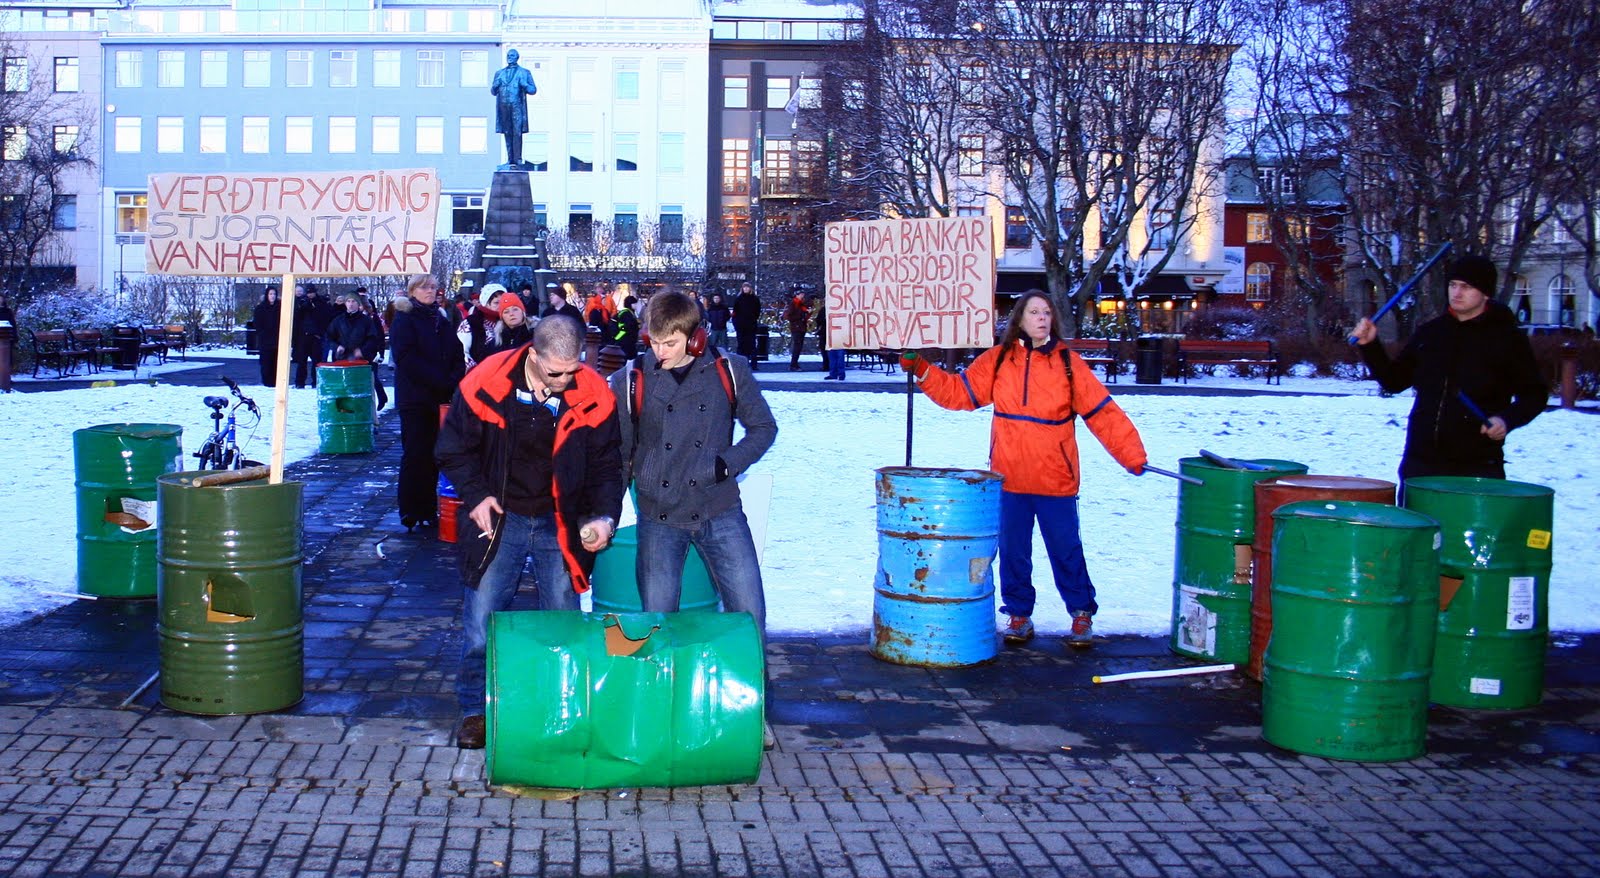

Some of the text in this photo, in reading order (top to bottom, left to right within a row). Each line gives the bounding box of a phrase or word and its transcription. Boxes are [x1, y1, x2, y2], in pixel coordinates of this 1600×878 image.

[152, 171, 429, 214] VERÐTRYGGING
[900, 219, 987, 254] BANKAR
[149, 239, 430, 272] VANHÆFNINNAR
[829, 281, 977, 311] SKILANEFNDIR
